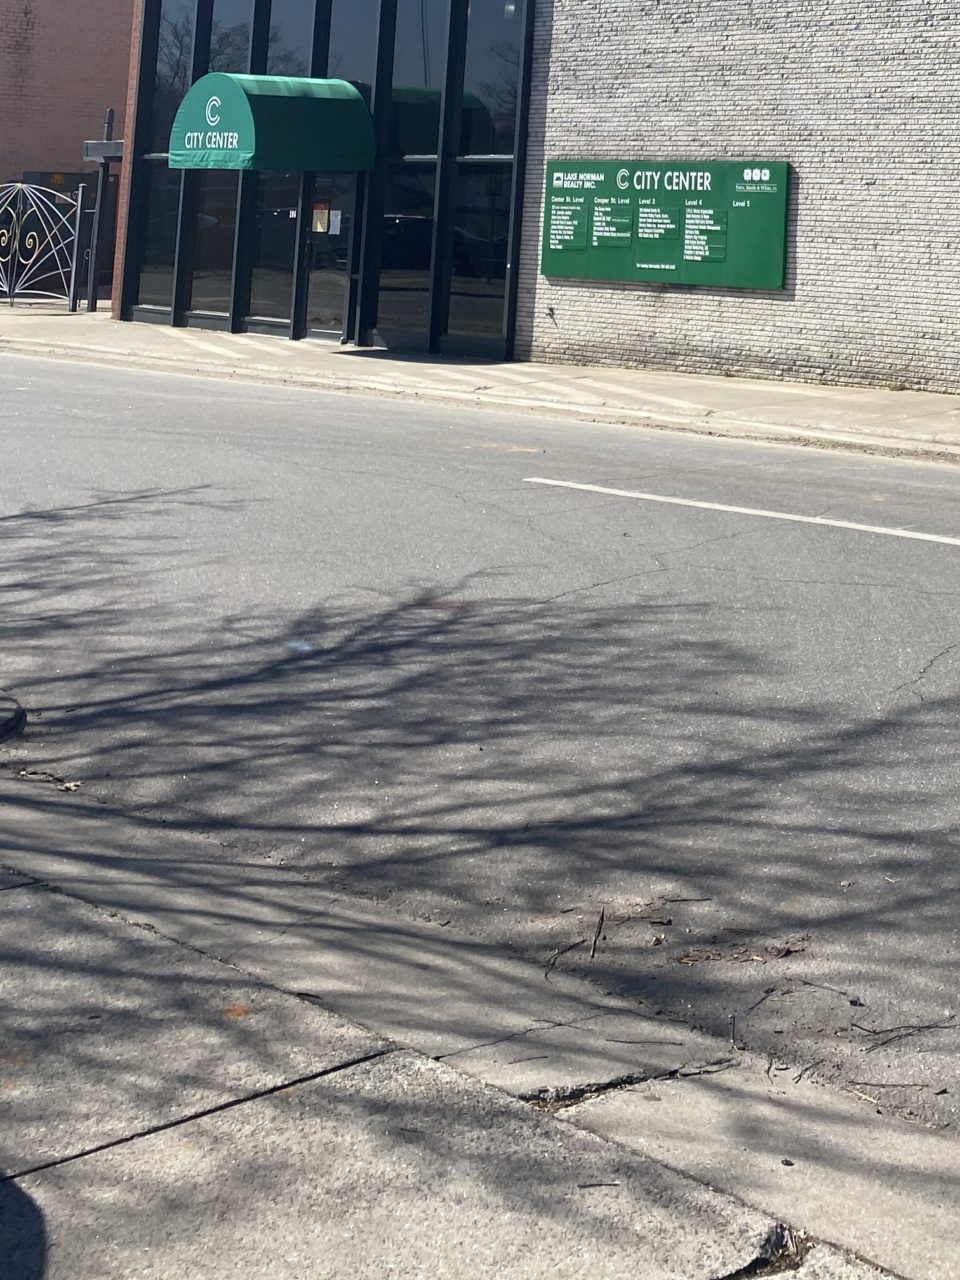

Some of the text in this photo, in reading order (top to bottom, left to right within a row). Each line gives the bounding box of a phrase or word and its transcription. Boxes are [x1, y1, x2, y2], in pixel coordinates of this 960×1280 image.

[184, 131, 239, 149] CITY CENTER
[564, 173, 604, 181] LAKE NORMAN
[633, 171, 660, 190] CITY
[664, 171, 711, 191] CENTER
[563, 181, 596, 189] REALTY INC.
